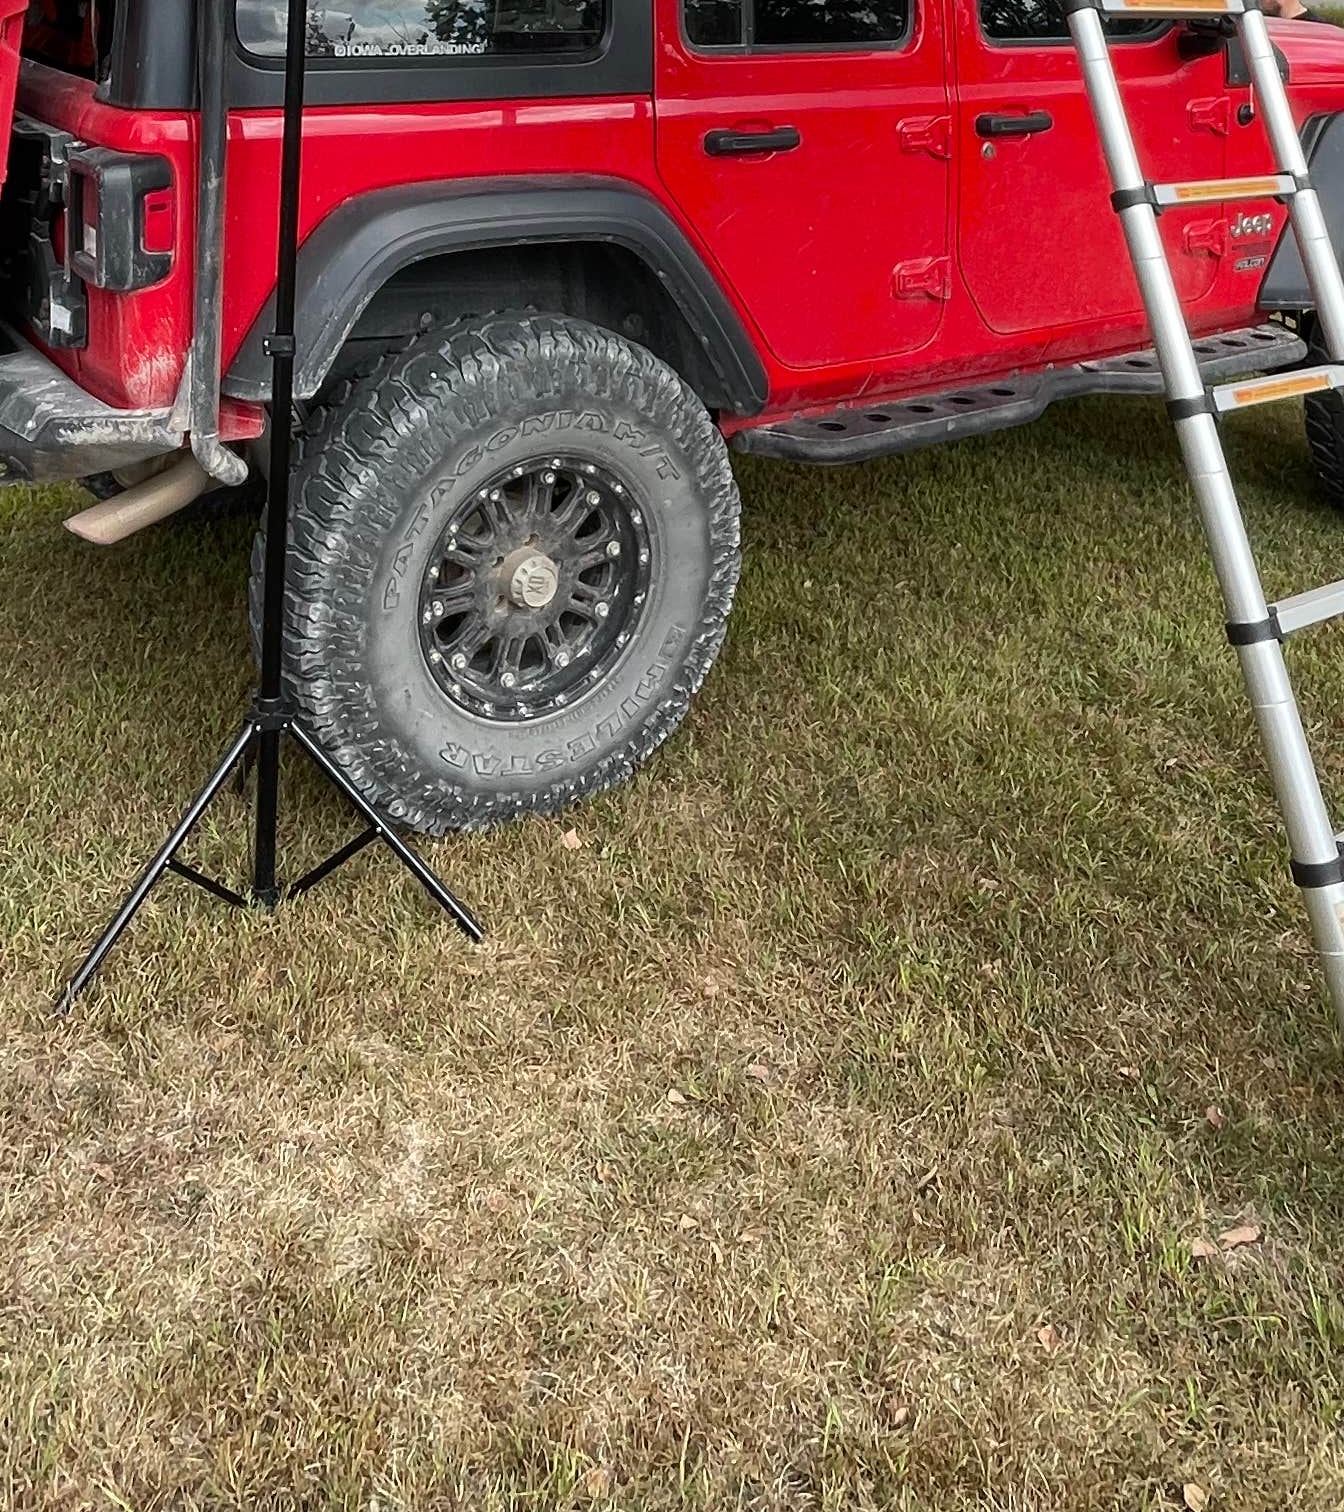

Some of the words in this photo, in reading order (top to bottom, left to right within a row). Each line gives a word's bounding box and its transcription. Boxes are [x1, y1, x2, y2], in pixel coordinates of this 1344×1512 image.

[1230, 212, 1272, 238] Jeep
[383, 411, 609, 610] PATAGONIA
[612, 422, 681, 482] M/T
[438, 661, 667, 776] MILESTAR
